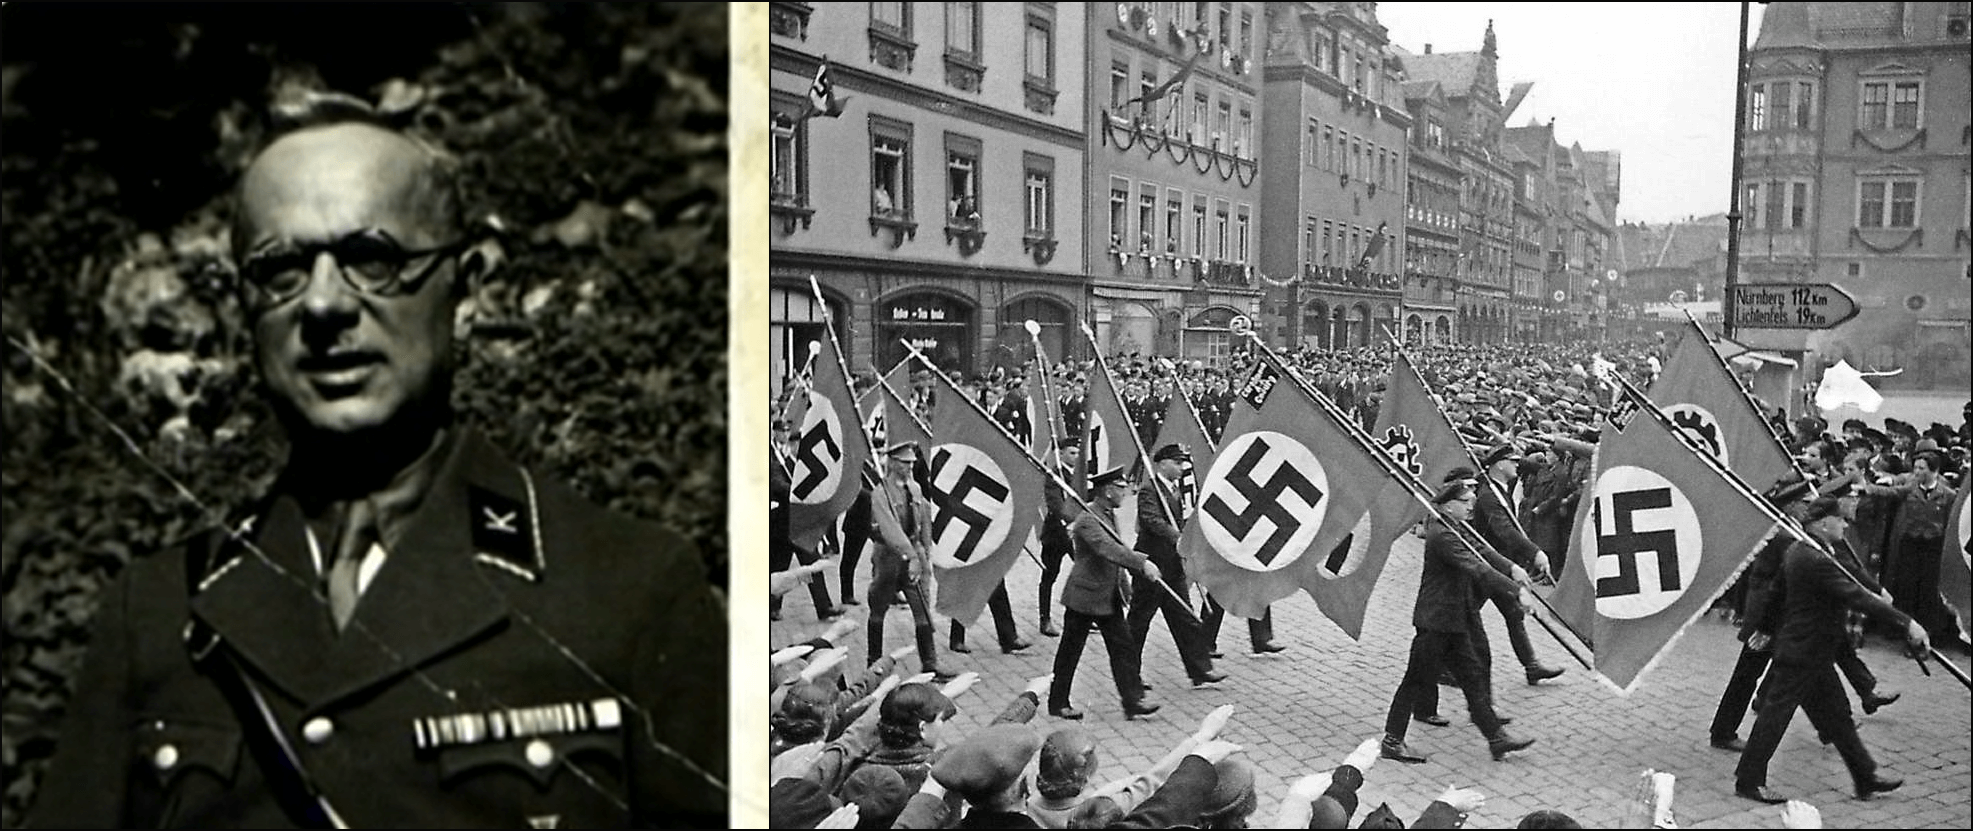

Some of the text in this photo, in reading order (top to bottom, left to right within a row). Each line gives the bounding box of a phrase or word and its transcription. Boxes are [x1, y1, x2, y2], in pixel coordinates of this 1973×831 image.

[1792, 288, 1811, 306] 112
[1797, 307, 1811, 324] 19
[482, 506, 518, 534] K
